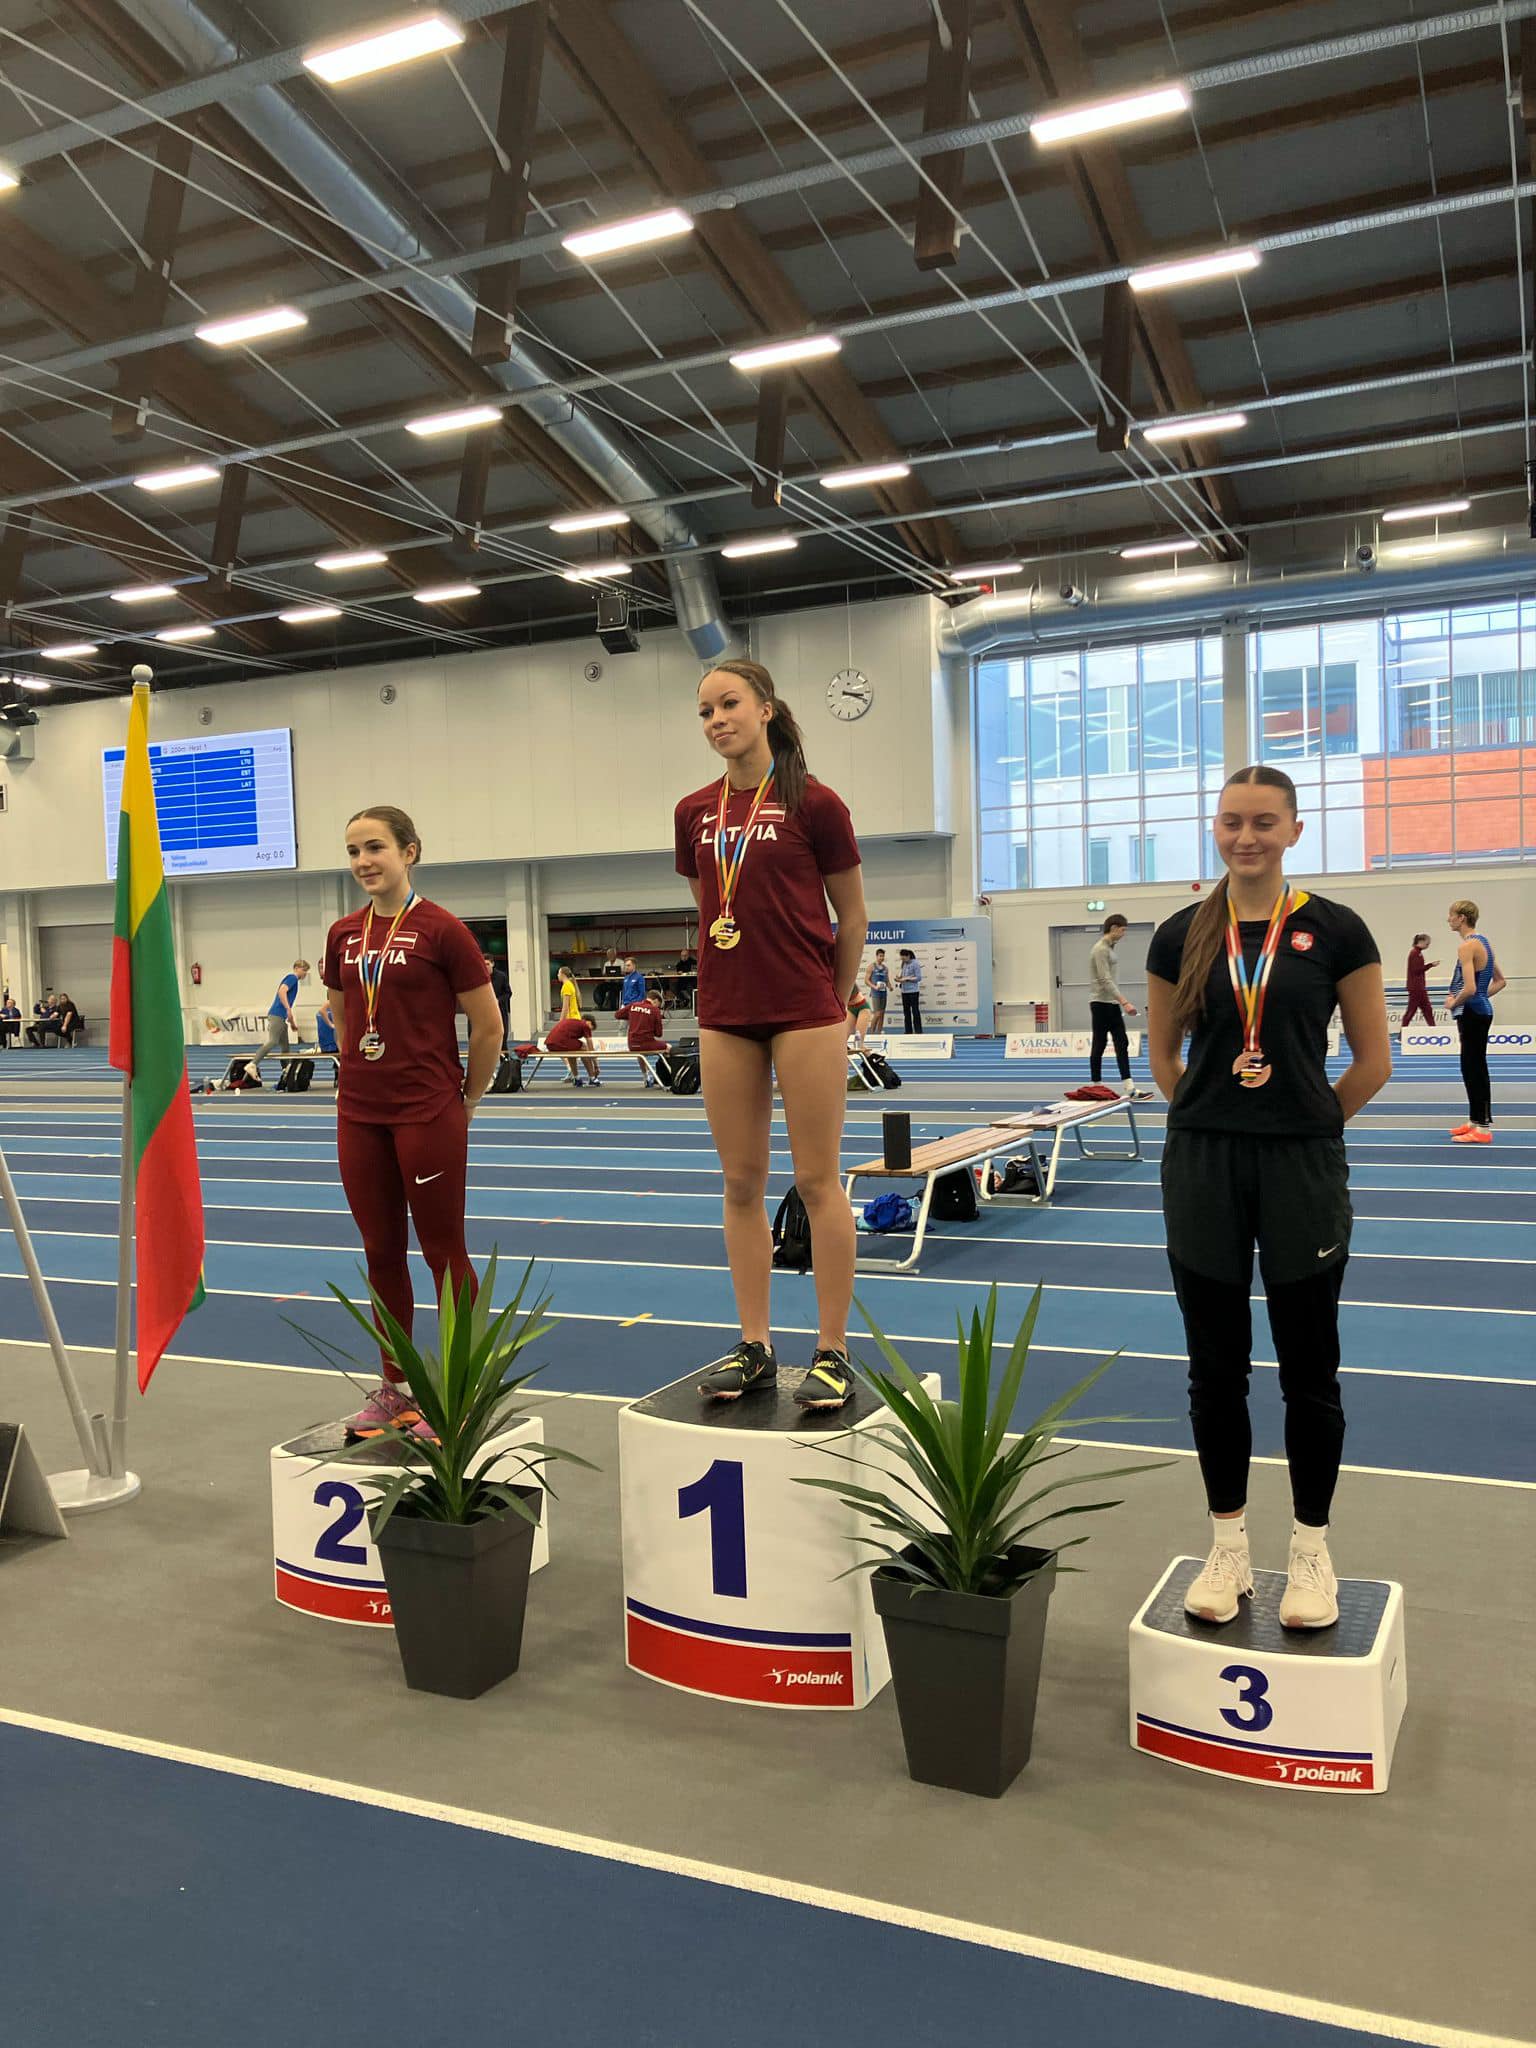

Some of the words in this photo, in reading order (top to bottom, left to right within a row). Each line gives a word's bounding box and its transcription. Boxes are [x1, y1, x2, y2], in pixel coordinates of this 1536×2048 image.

[865, 929, 905, 941] TIKULIIT
[221, 1016, 269, 1032] UTILIT
[1407, 1035, 1451, 1046] coop
[1487, 1034, 1531, 1046] coop
[313, 1480, 368, 1566] 2
[678, 1459, 748, 1599] 1
[785, 1670, 844, 1687] polanik
[1218, 1664, 1273, 1732] 3
[1293, 1765, 1363, 1783] polanik
